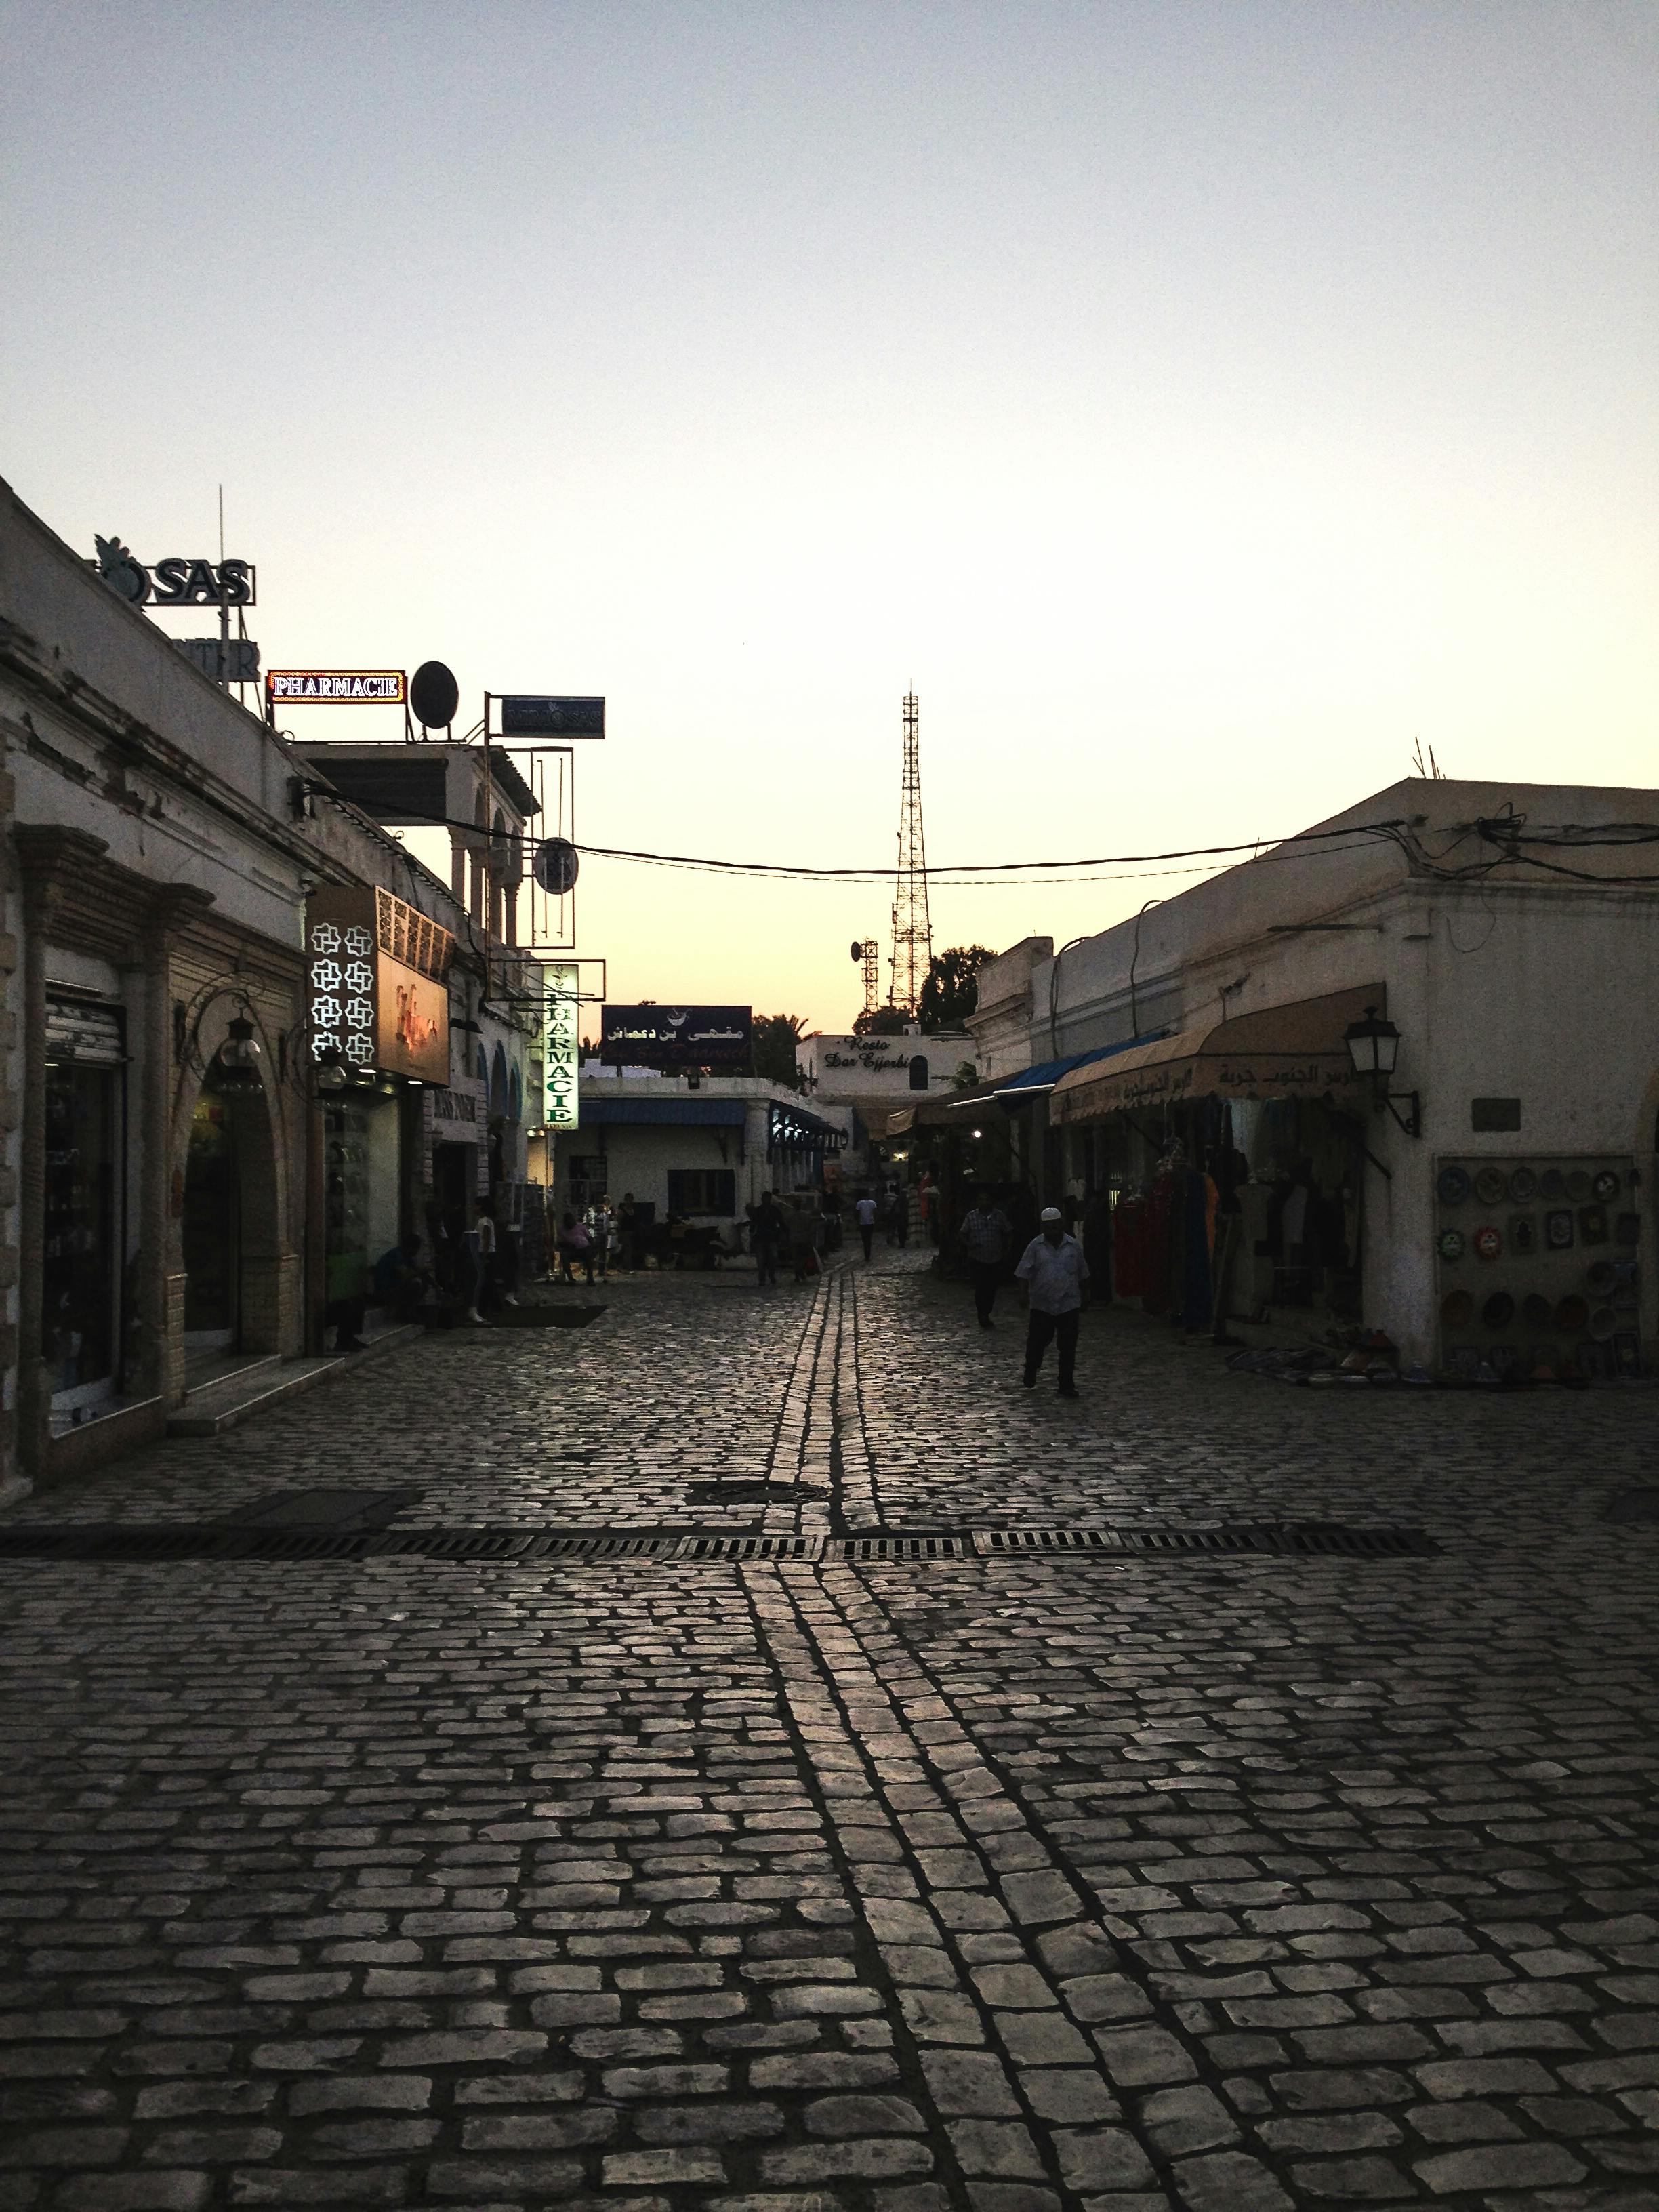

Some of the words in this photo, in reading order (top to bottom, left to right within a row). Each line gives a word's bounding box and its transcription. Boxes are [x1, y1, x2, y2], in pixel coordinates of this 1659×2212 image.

[273, 676, 398, 697] PHARMACIE
[659, 1029, 677, 1042] بن
[687, 1026, 745, 1042] مقهى
[844, 1036, 890, 1050] Resto
[825, 1052, 857, 1068] Dar
